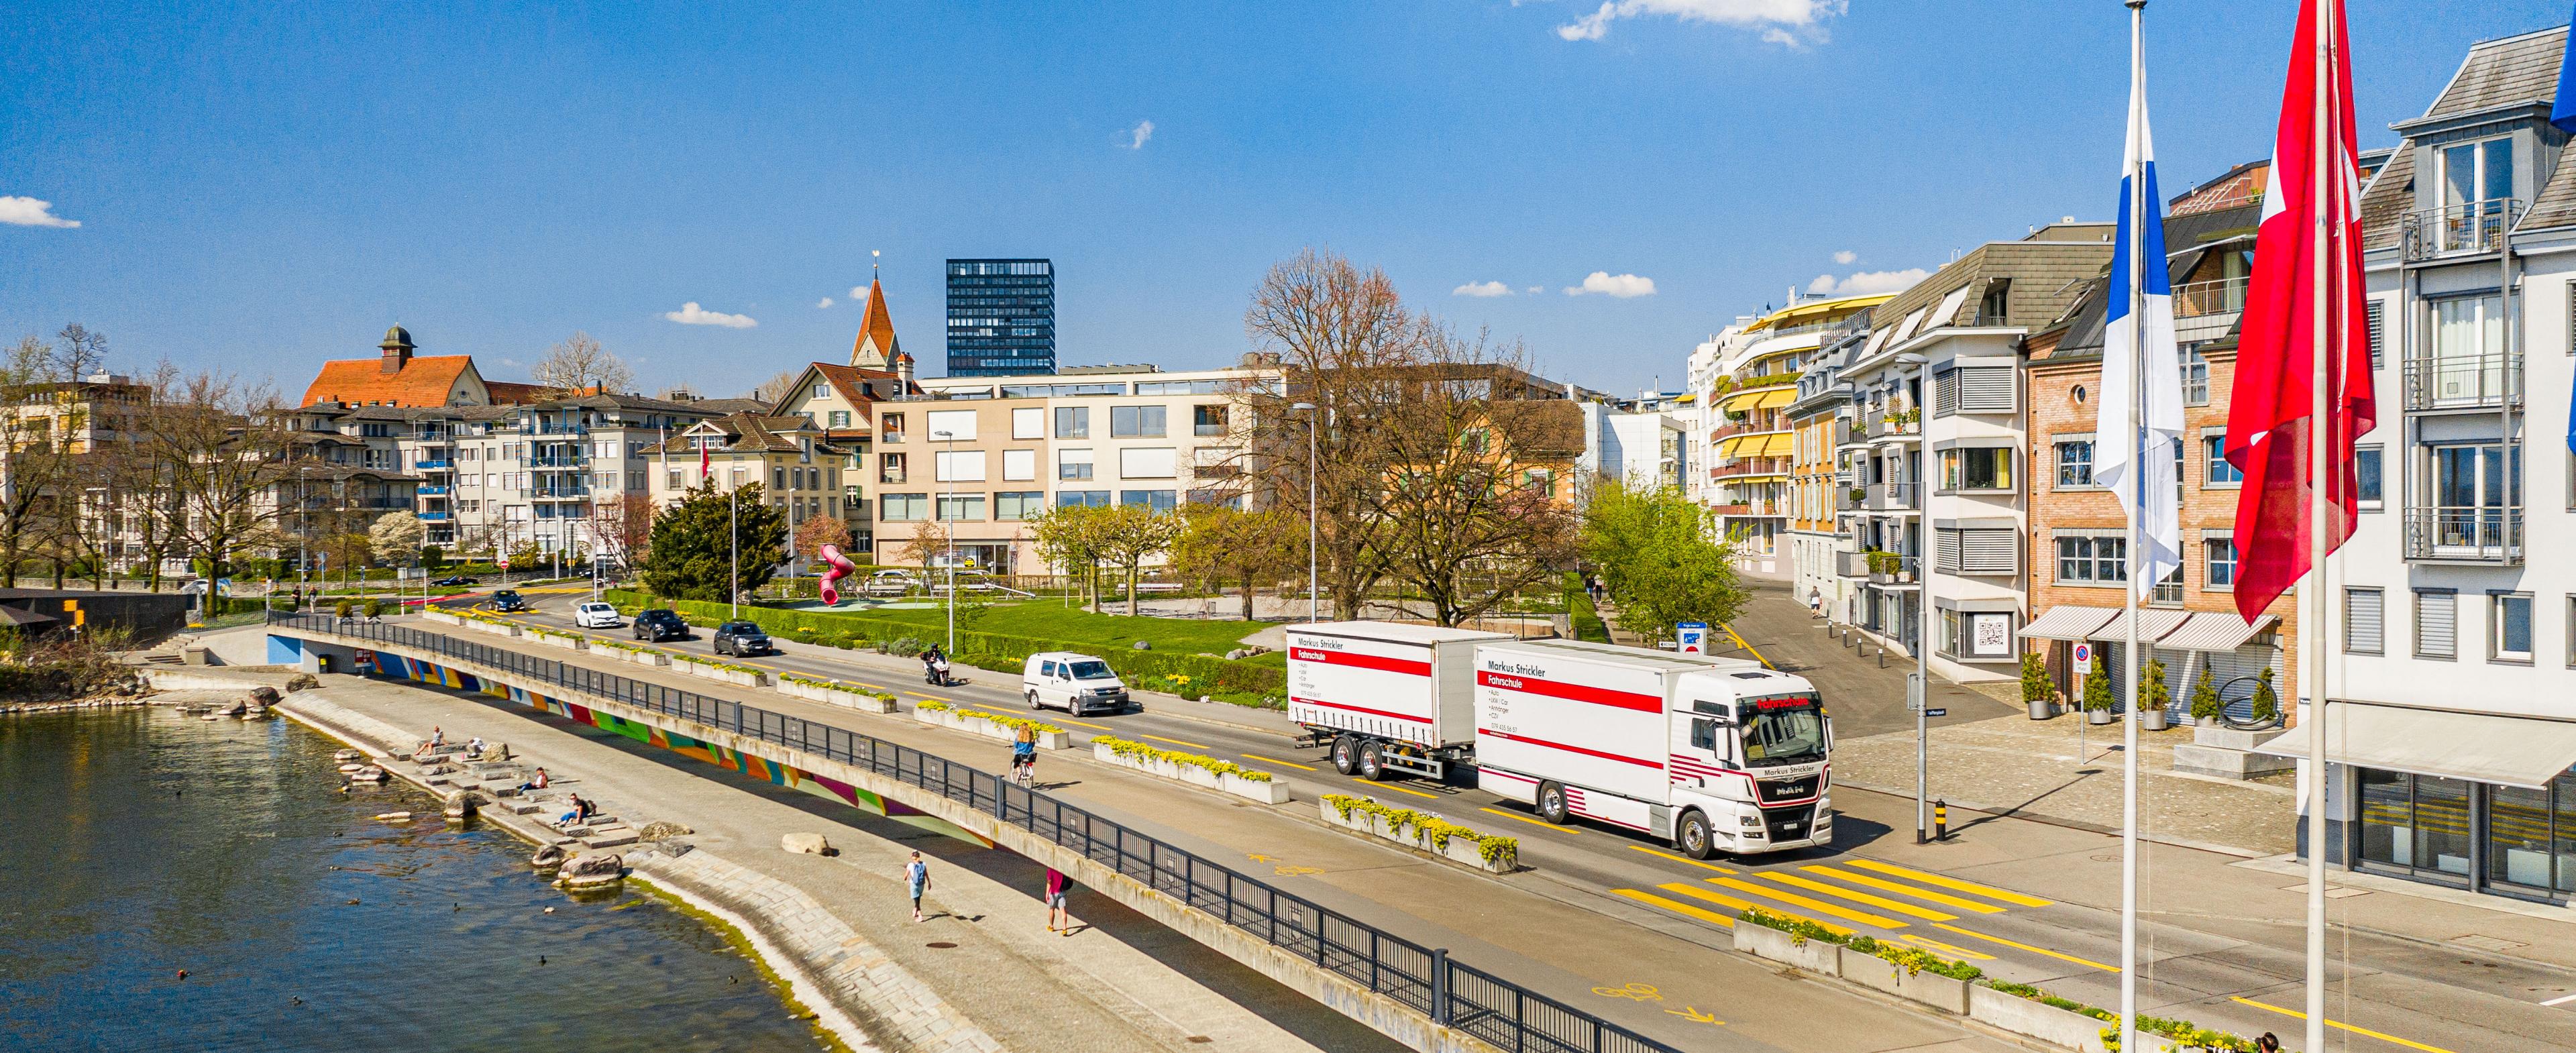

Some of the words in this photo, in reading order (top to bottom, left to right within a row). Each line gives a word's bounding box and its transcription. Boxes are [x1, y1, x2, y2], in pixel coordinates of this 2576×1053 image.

[1298, 638, 1319, 647] Markus
[1320, 640, 1343, 649] Strickler
[1298, 649, 1326, 661] Fahrschule
[1488, 660, 1514, 673] Markus
[1516, 664, 1546, 677] Strickler
[1488, 675, 1523, 688] Fahrschule
[1757, 698, 1809, 709] Fahrschule
[1764, 768, 1788, 776] Markus
[1790, 765, 1815, 773] Strickler
[1776, 785, 1804, 795] MAN
